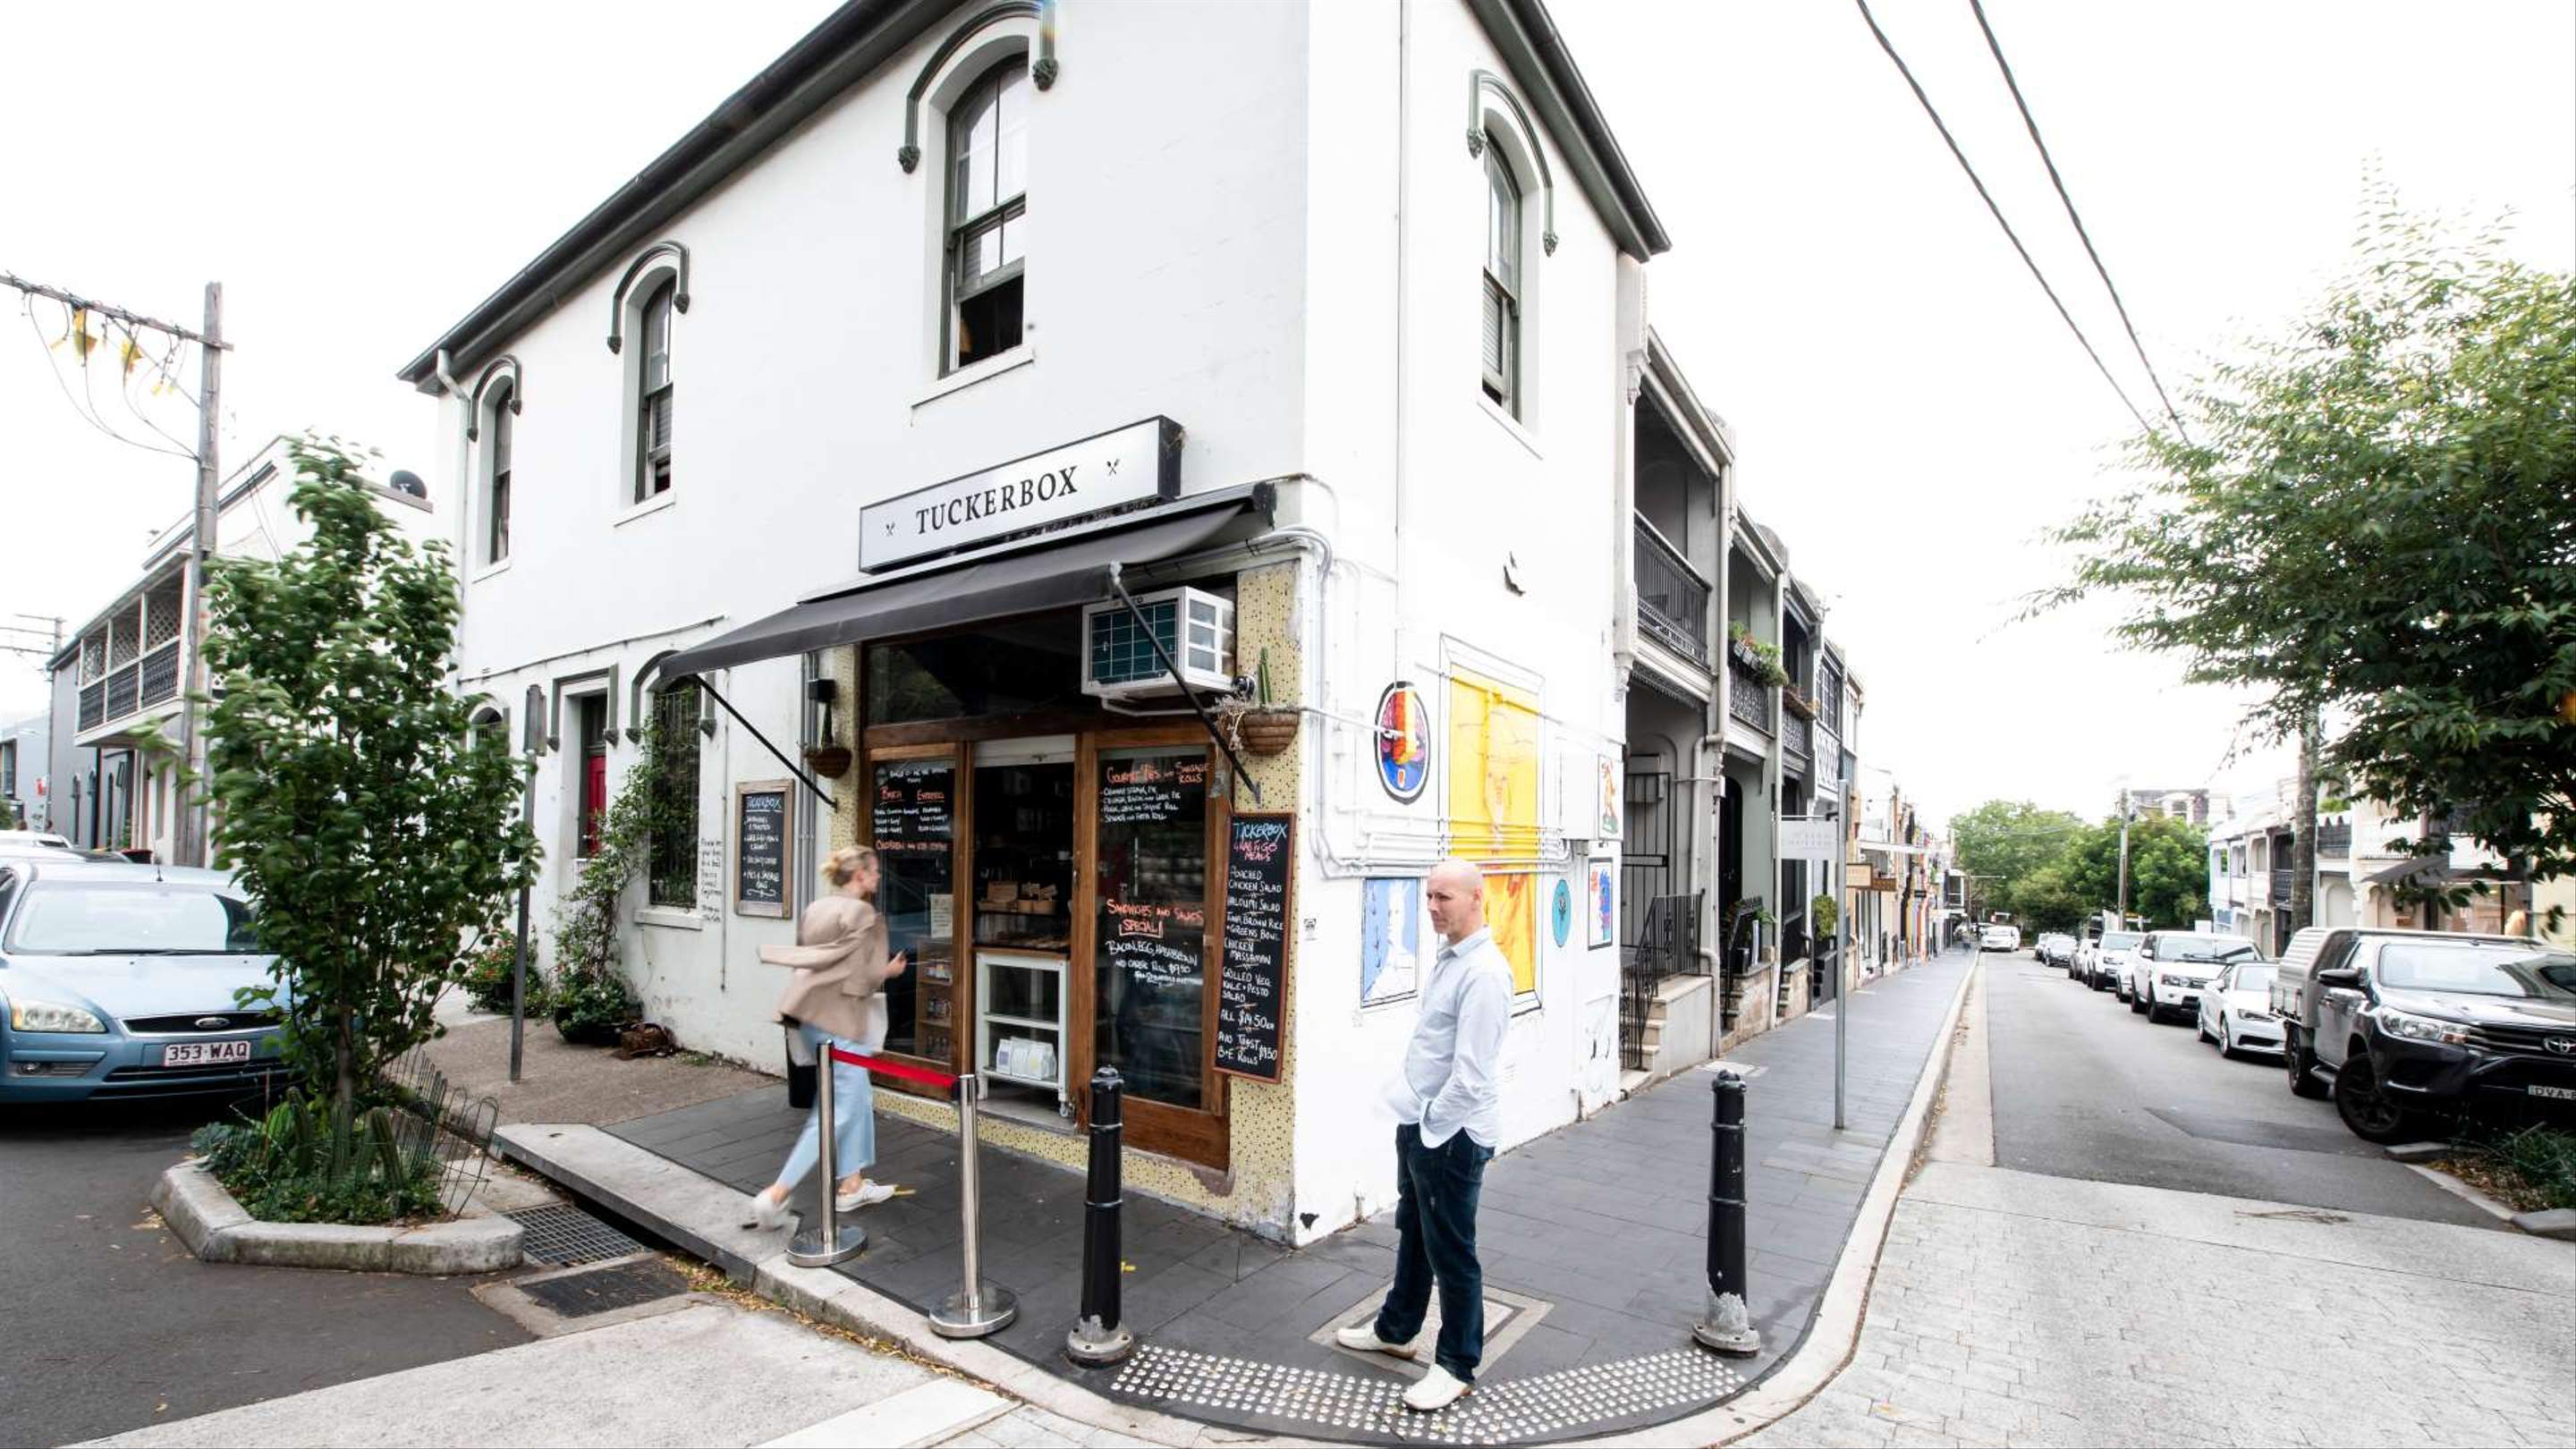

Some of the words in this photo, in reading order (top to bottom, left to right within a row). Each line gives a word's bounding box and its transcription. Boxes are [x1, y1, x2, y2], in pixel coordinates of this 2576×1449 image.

[916, 465, 1079, 534] TUCKERBOX
[1244, 851, 1271, 862] MEALS
[1228, 878, 1258, 891] CHICKEN
[1259, 880, 1282, 893] SALAD
[1259, 898, 1281, 912] SALAD
[1122, 918, 1158, 933] SPECIAL
[1242, 913, 1267, 928] BROWN
[1268, 917, 1284, 930] RICE
[1223, 936, 1254, 952] CHICKEN
[1229, 949, 1272, 965] MASSAMAN
[1223, 966, 1252, 983] GRILLED
[1222, 989, 1246, 1003] SALAD
[1247, 983, 1270, 997] PESTO
[1220, 1008, 1235, 1022] ALL
[1237, 1049, 1258, 1066] ROLLS
